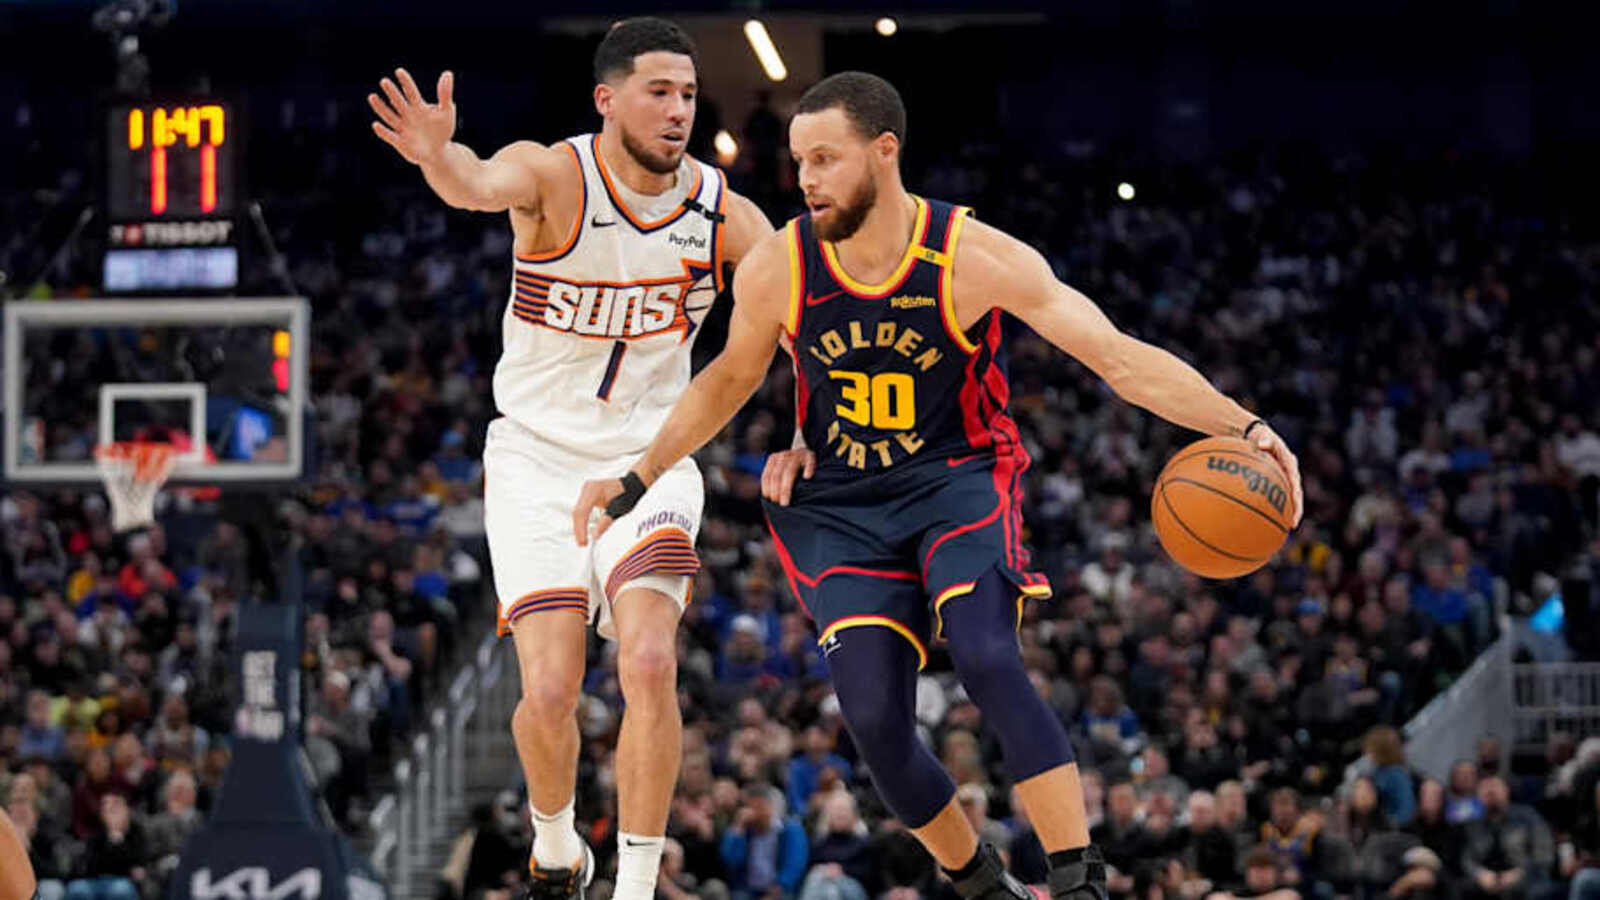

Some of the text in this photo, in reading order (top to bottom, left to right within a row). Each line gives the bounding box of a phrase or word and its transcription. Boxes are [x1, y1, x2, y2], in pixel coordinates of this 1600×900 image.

[668, 232, 706, 249] PayPal
[544, 281, 681, 337] SUNS
[596, 340, 627, 402] 1
[827, 369, 916, 430] 30
[1207, 456, 1287, 515] Wilson
